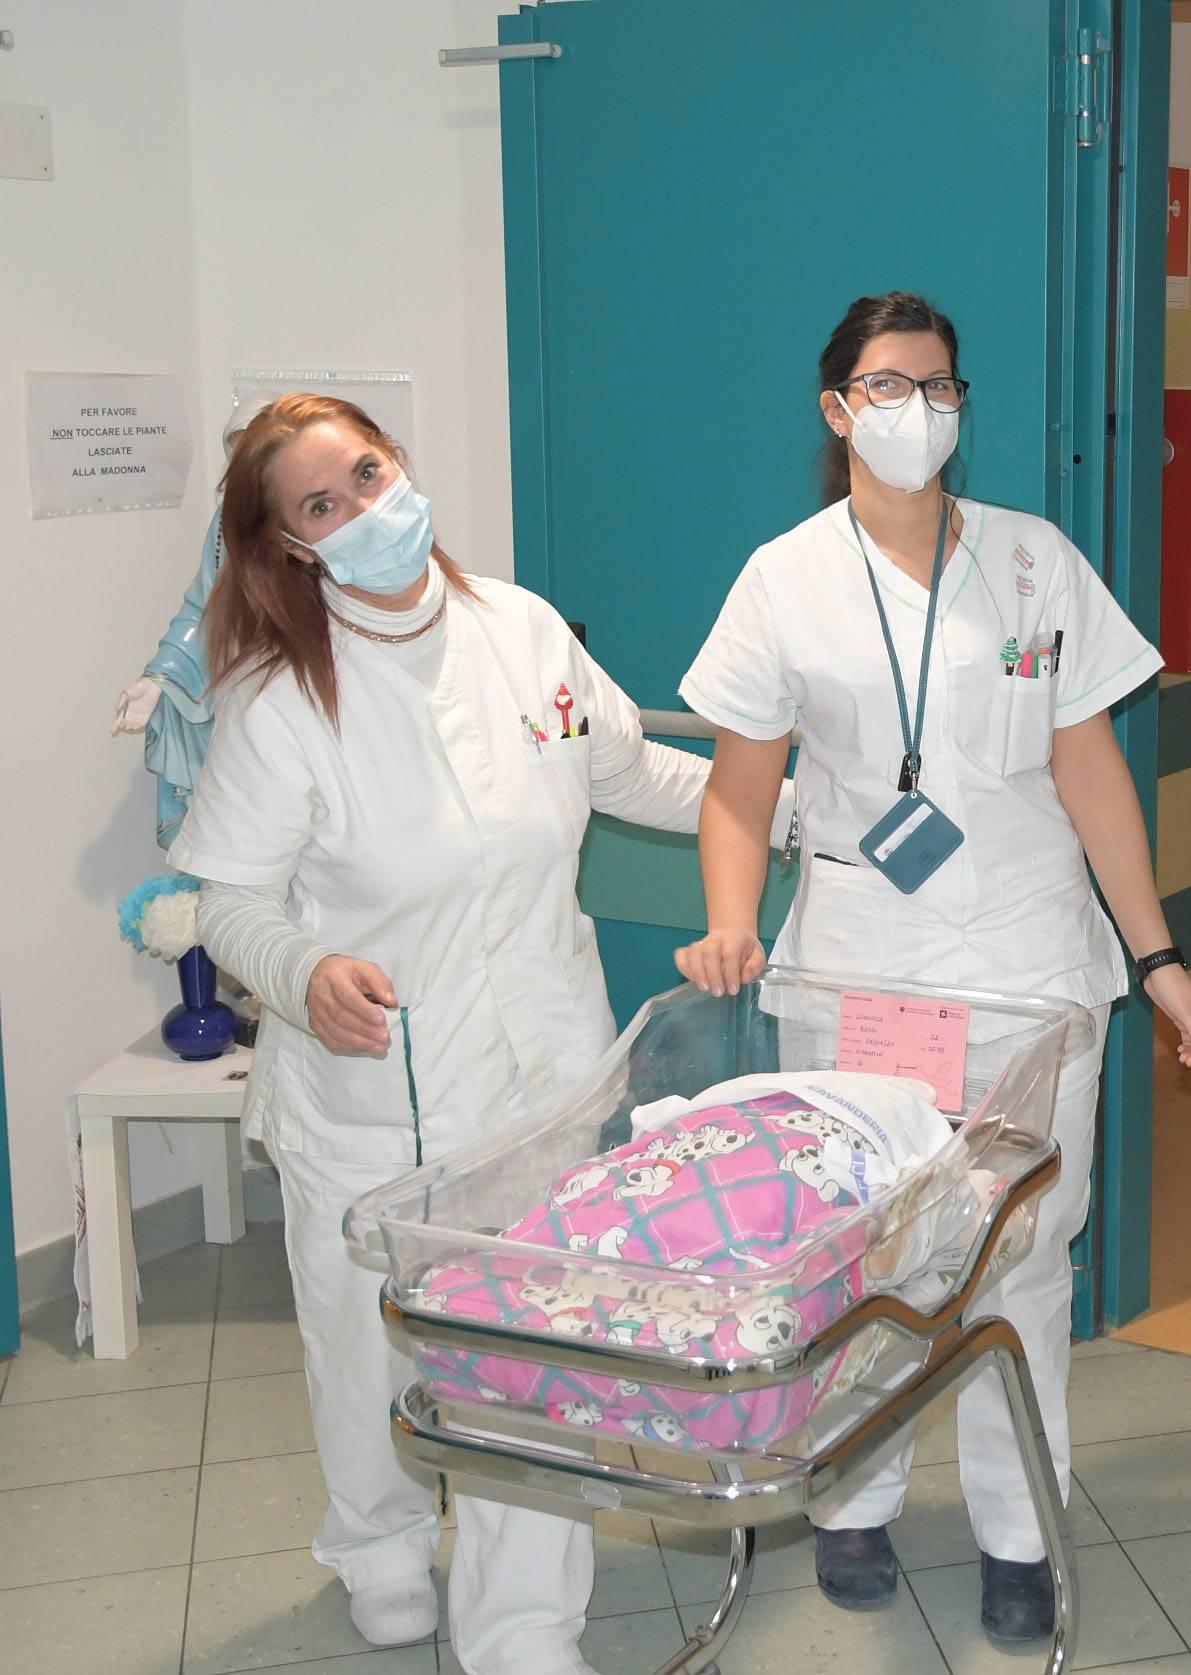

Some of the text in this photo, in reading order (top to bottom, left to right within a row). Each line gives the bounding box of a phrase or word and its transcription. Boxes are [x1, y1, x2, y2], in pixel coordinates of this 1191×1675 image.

[80, 407, 138, 417] PER FAVORE
[52, 426, 168, 438] NON TOCCARE LE PIANTE
[88, 446, 133, 456] LASCIATE
[72, 465, 146, 477] ALLA MADONNA
[808, 1084, 888, 1144] LAVANDERIA
